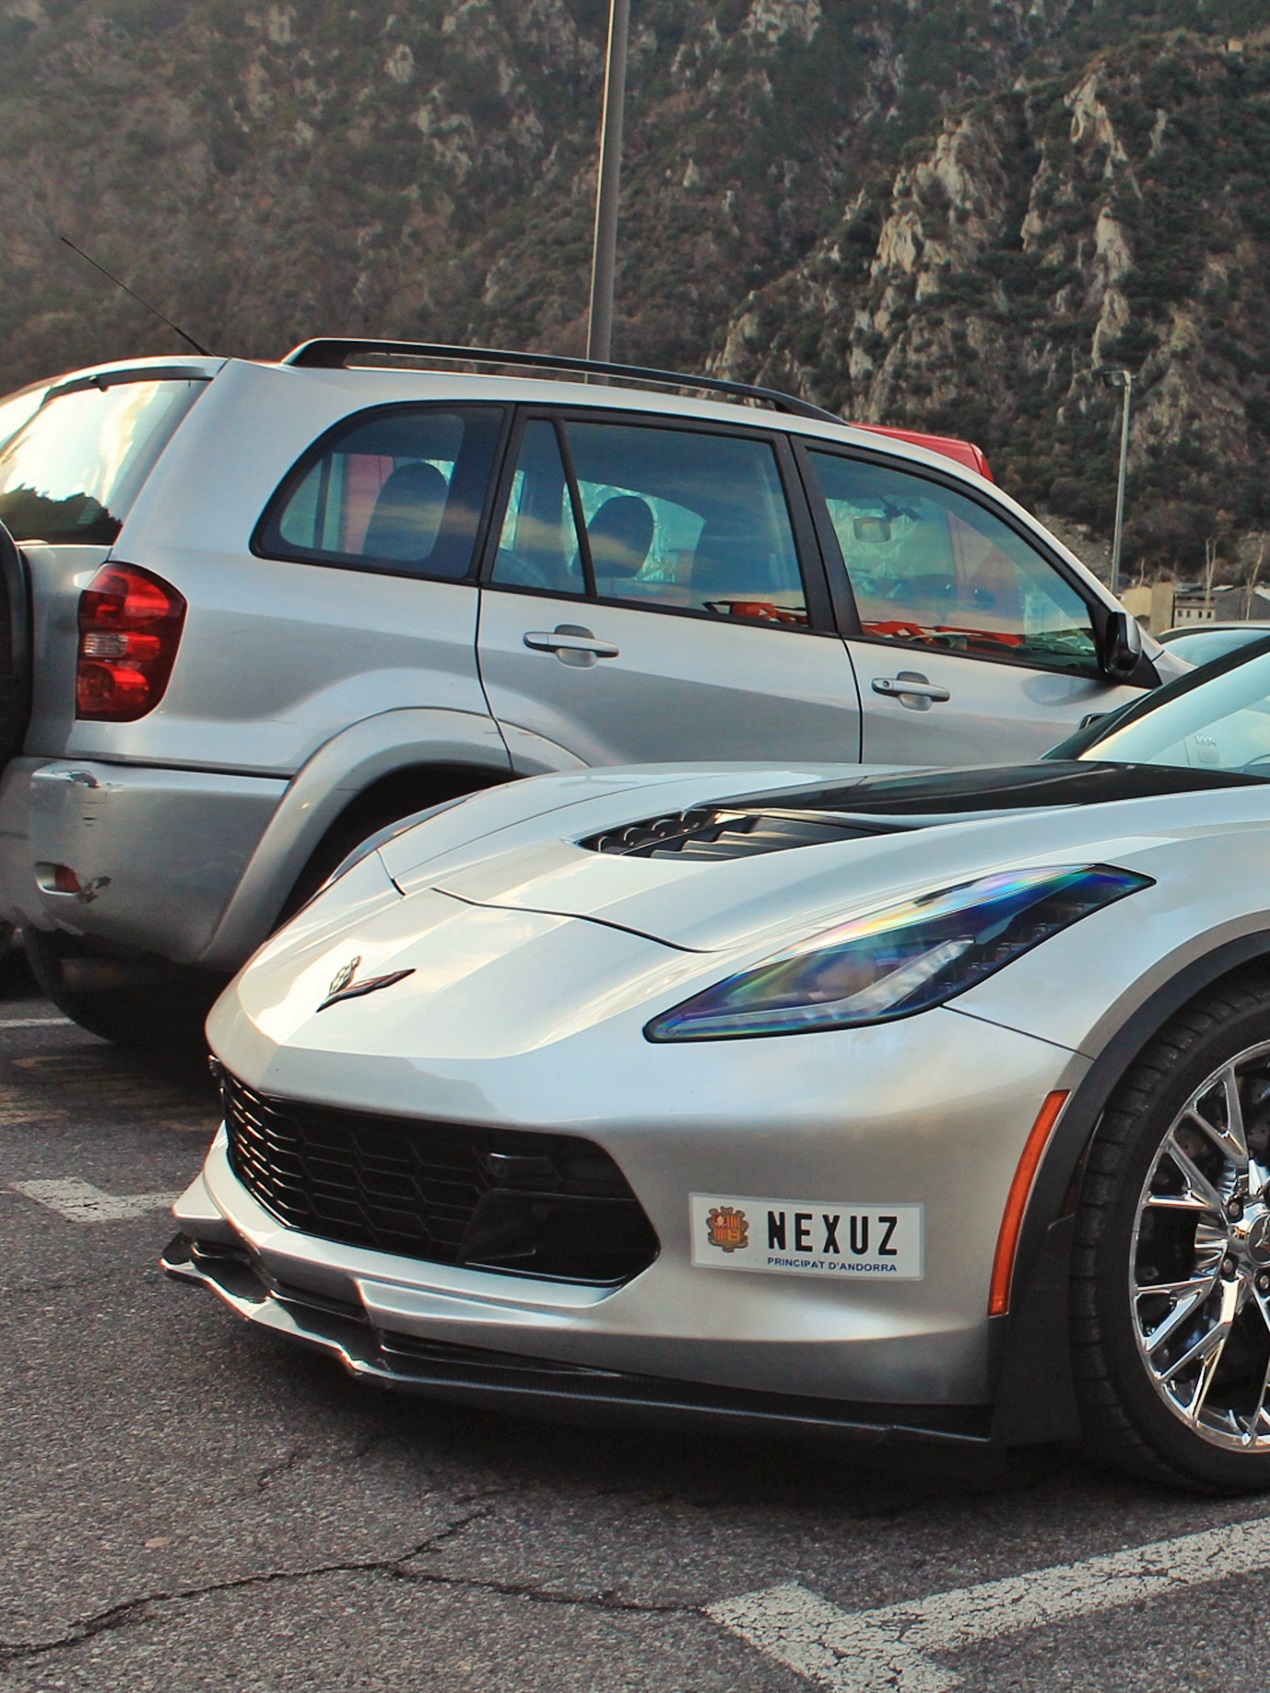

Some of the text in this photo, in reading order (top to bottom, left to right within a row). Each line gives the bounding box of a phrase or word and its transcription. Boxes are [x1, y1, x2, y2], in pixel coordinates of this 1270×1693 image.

[767, 1211, 898, 1255] NEXUZ
[767, 1257, 897, 1272] PRINCIPAT D'ANDORRA
